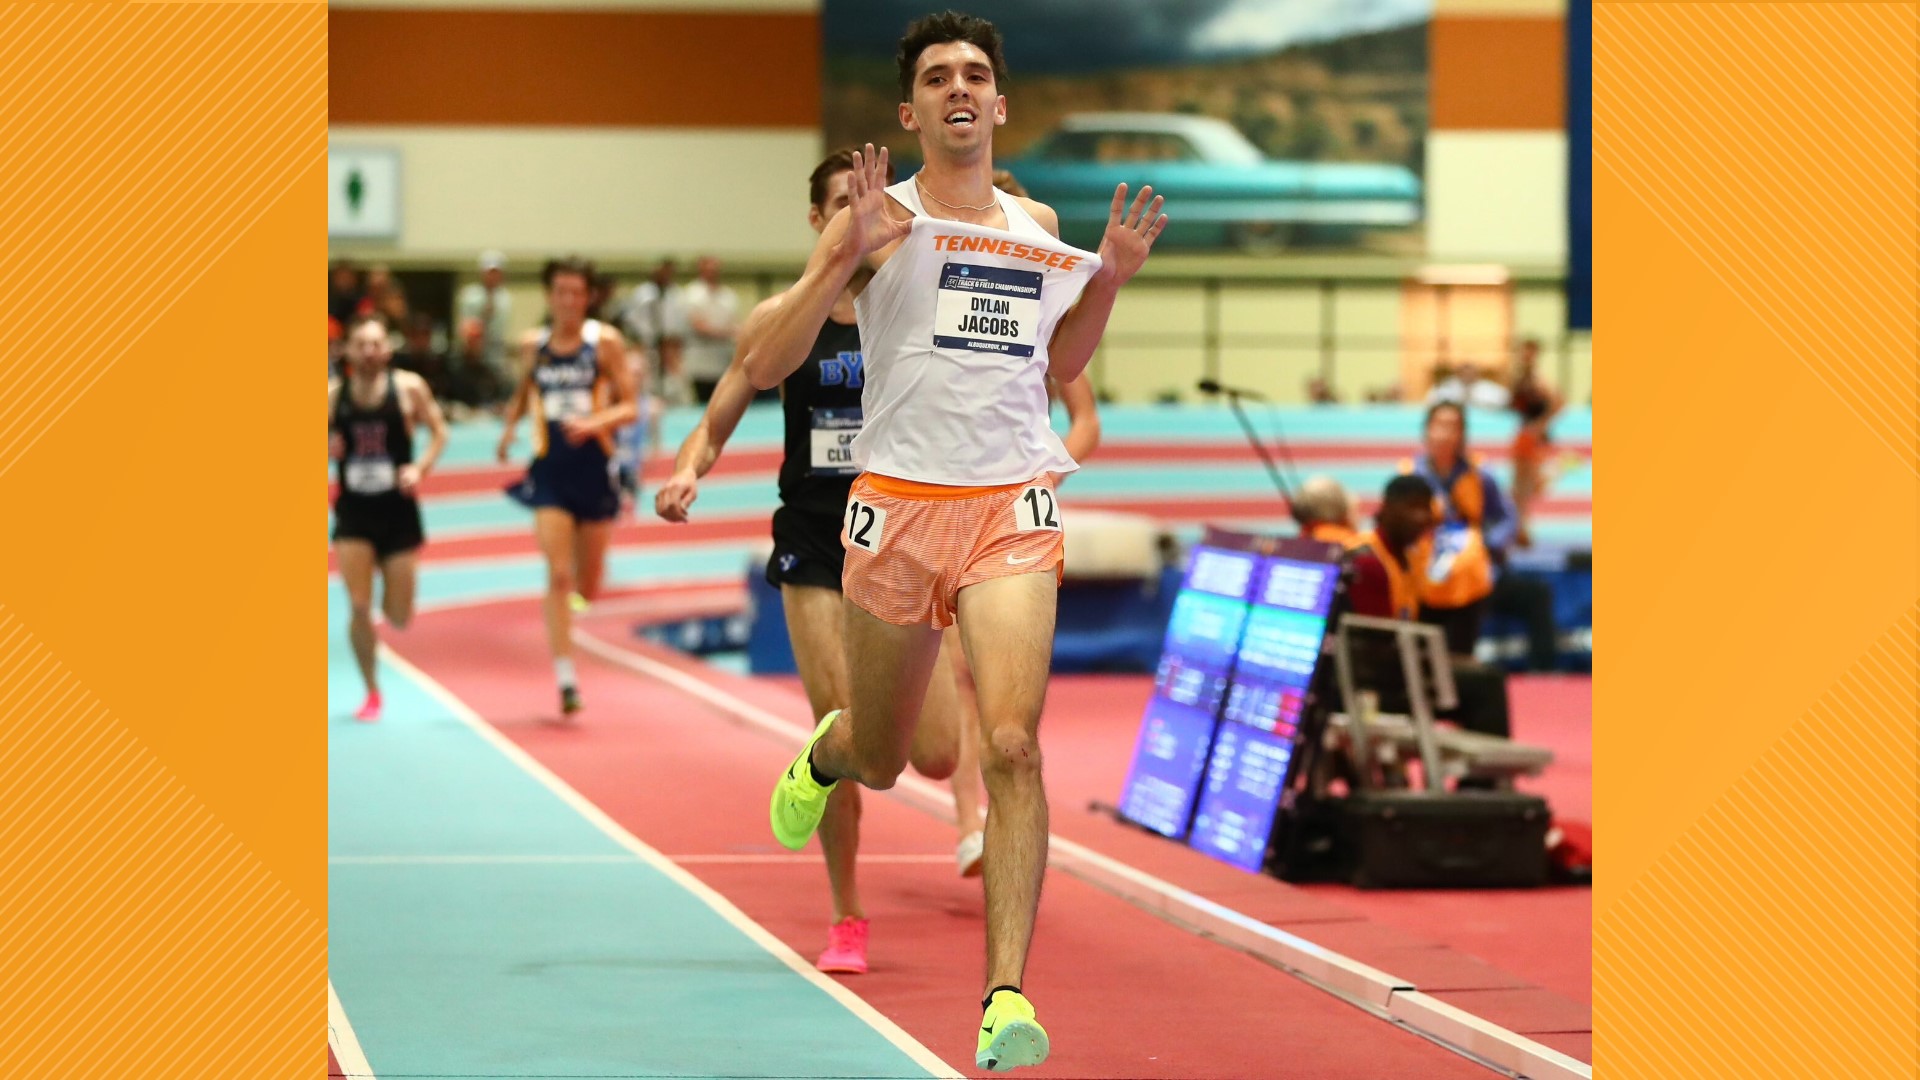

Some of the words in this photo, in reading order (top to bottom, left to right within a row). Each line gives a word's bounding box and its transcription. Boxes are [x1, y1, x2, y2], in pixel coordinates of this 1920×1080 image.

[933, 235, 1083, 271] TENNESSEE
[958, 279, 975, 287] TRACK
[979, 281, 995, 290] FIELD
[995, 283, 1037, 294] CHAMPIONSHIPS
[971, 297, 1010, 315] DYLAN
[958, 315, 1019, 337] JACOBS
[967, 341, 1001, 350] ALBUQUERQUE,
[819, 351, 864, 388] BY
[827, 449, 851, 462] CLI
[1024, 488, 1058, 528] 12
[849, 501, 875, 547] 12
